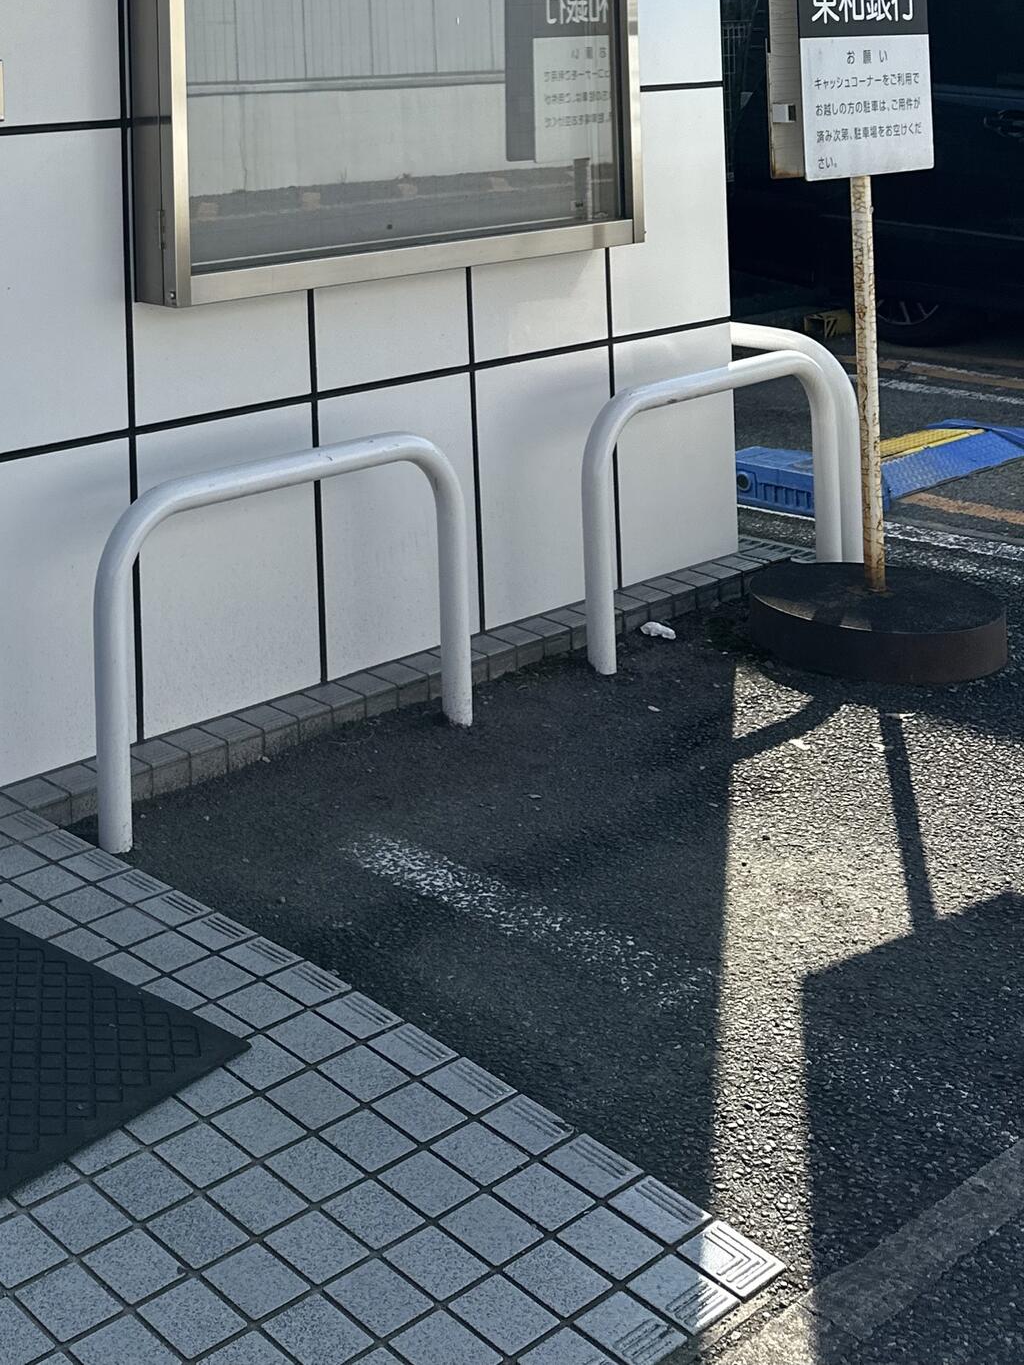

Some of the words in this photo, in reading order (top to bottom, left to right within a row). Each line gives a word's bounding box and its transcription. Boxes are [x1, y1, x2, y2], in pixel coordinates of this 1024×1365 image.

[814, 72, 920, 90] キャッシュコーナーをご利用で
[815, 96, 921, 117] お越しの方の駐車は、ご用件が
[816, 121, 923, 144] 済み次第、駐車場をお空けくだ
[817, 156, 838, 170] さい。
